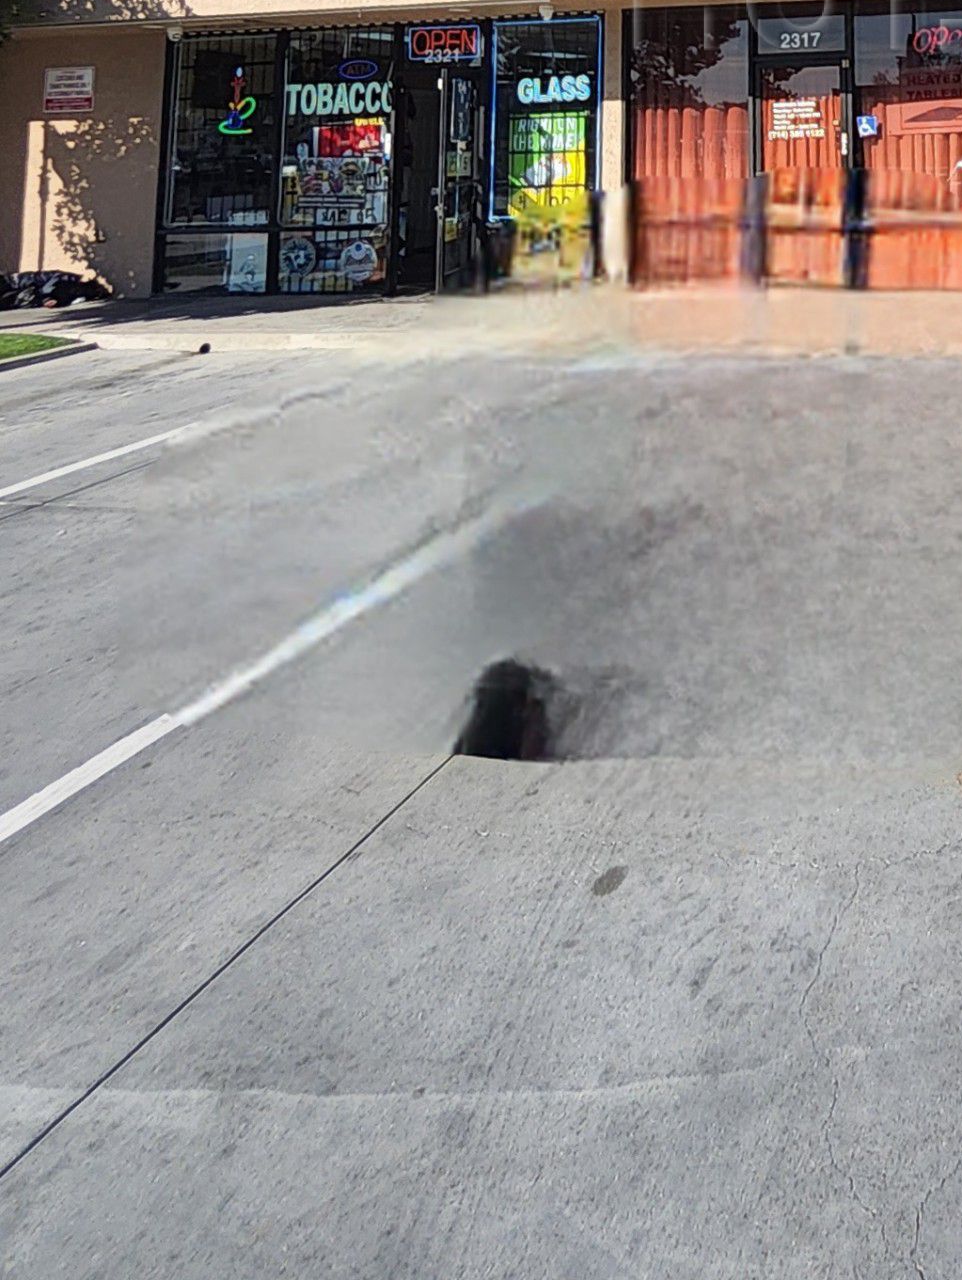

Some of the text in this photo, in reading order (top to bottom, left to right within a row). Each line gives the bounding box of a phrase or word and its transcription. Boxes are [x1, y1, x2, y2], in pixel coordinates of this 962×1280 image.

[412, 29, 477, 55] OPEN
[780, 32, 821, 48] 2317
[424, 47, 460, 64] 2321
[907, 72, 961, 85] HEATED
[517, 74, 591, 104] GLASS
